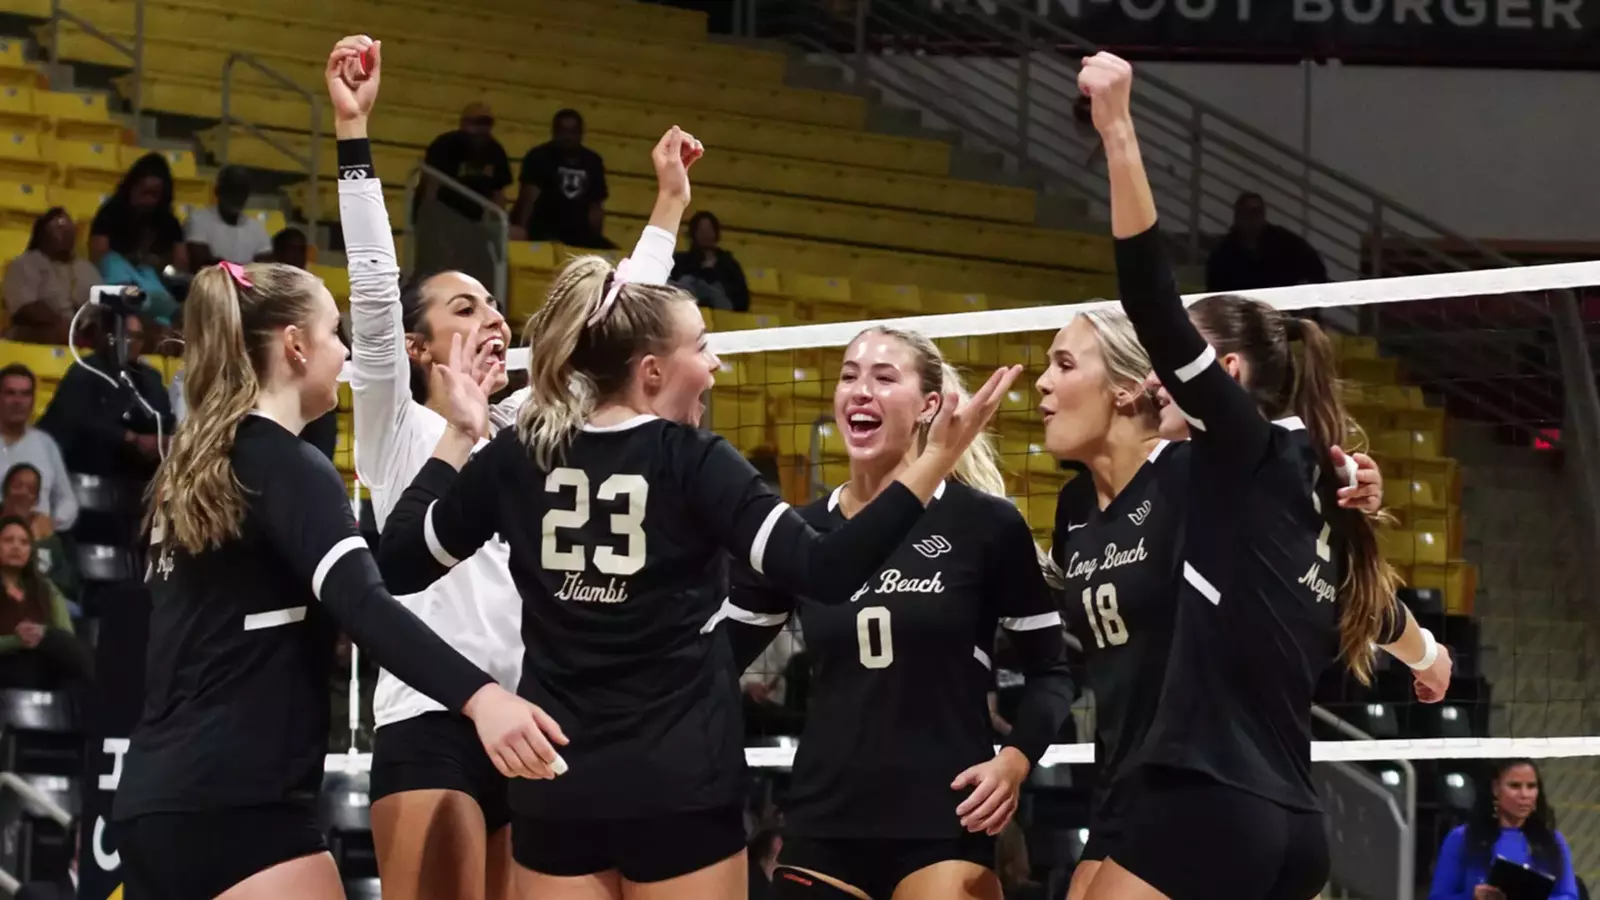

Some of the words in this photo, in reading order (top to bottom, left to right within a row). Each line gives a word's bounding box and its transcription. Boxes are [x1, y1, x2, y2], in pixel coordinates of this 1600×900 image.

[541, 467, 649, 576] 23
[874, 569, 945, 594] Beach
[1066, 551, 1097, 581] Long
[1099, 537, 1148, 570] Beach
[1298, 562, 1337, 603] Meyer
[856, 606, 894, 669] 0
[1082, 582, 1129, 649] 18
